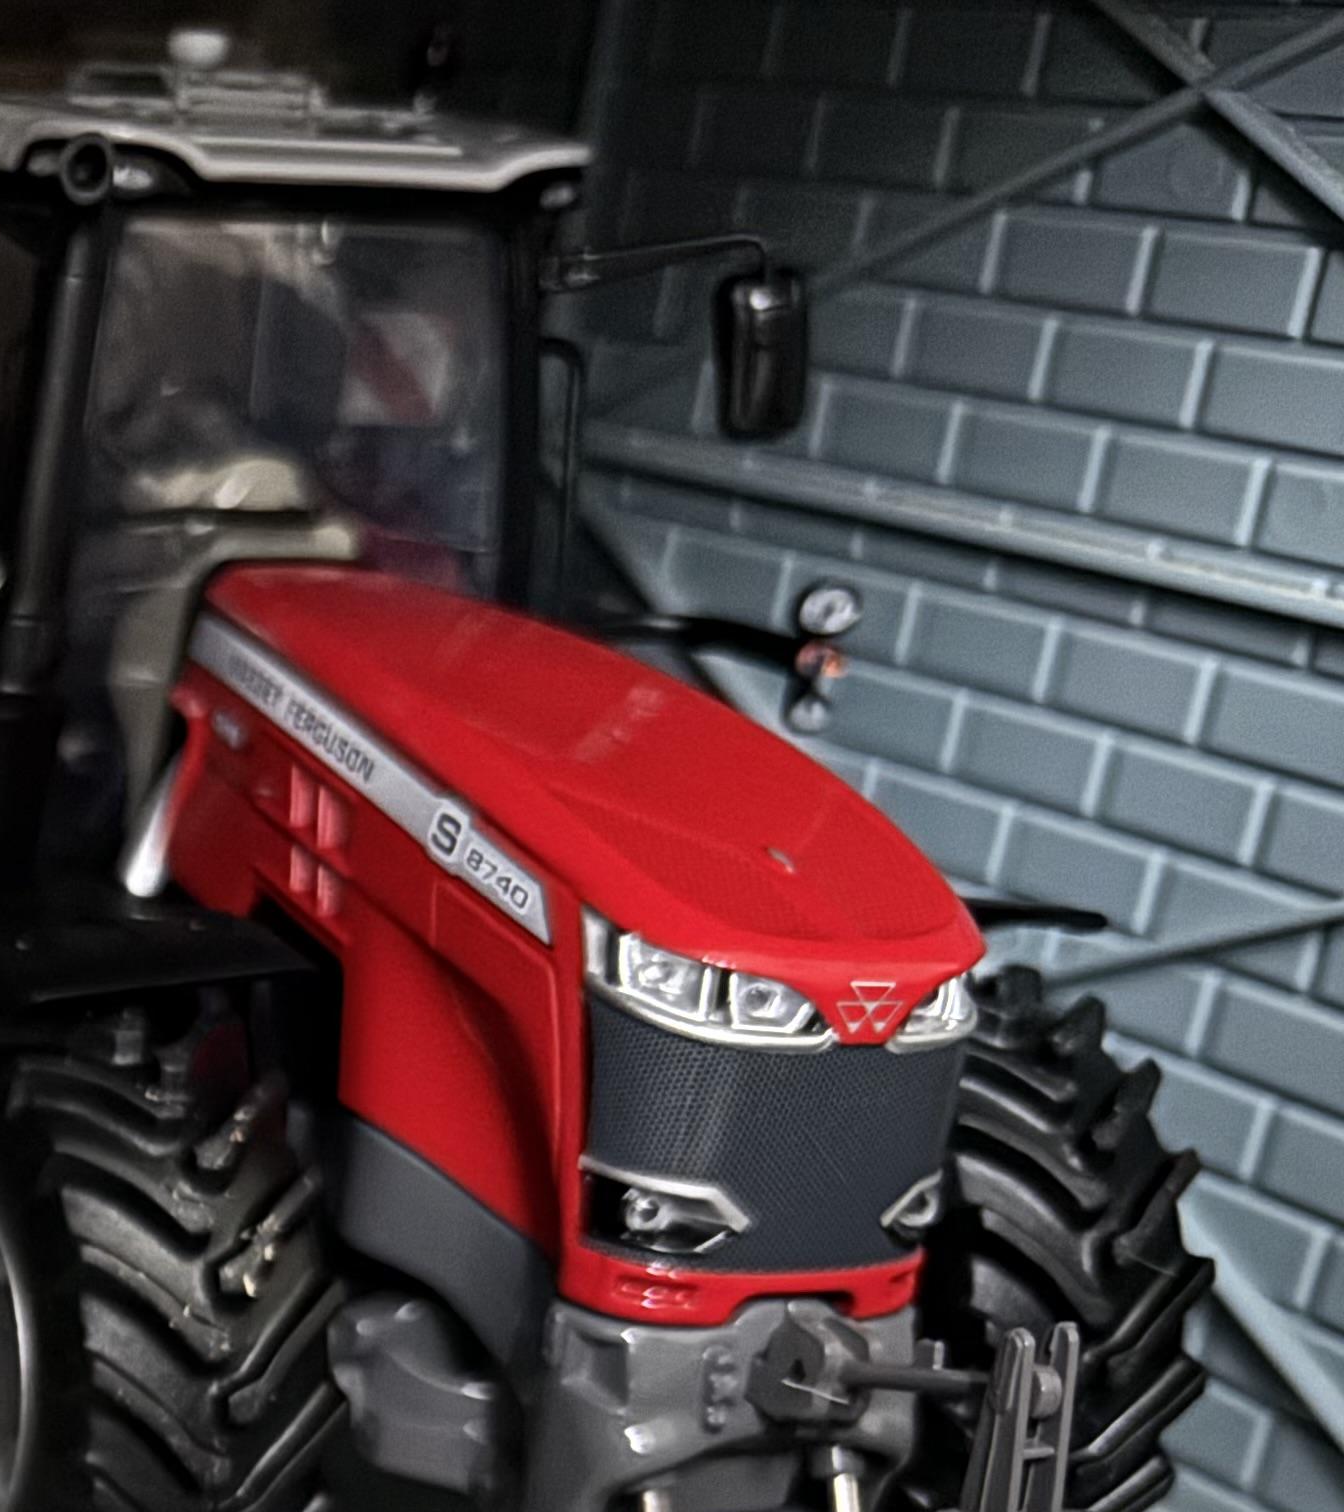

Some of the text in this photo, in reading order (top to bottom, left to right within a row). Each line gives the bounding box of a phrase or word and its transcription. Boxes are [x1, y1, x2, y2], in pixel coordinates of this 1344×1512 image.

[284, 697, 375, 783] FERGUSON
[431, 812, 462, 857] S
[466, 848, 529, 910] 8740
